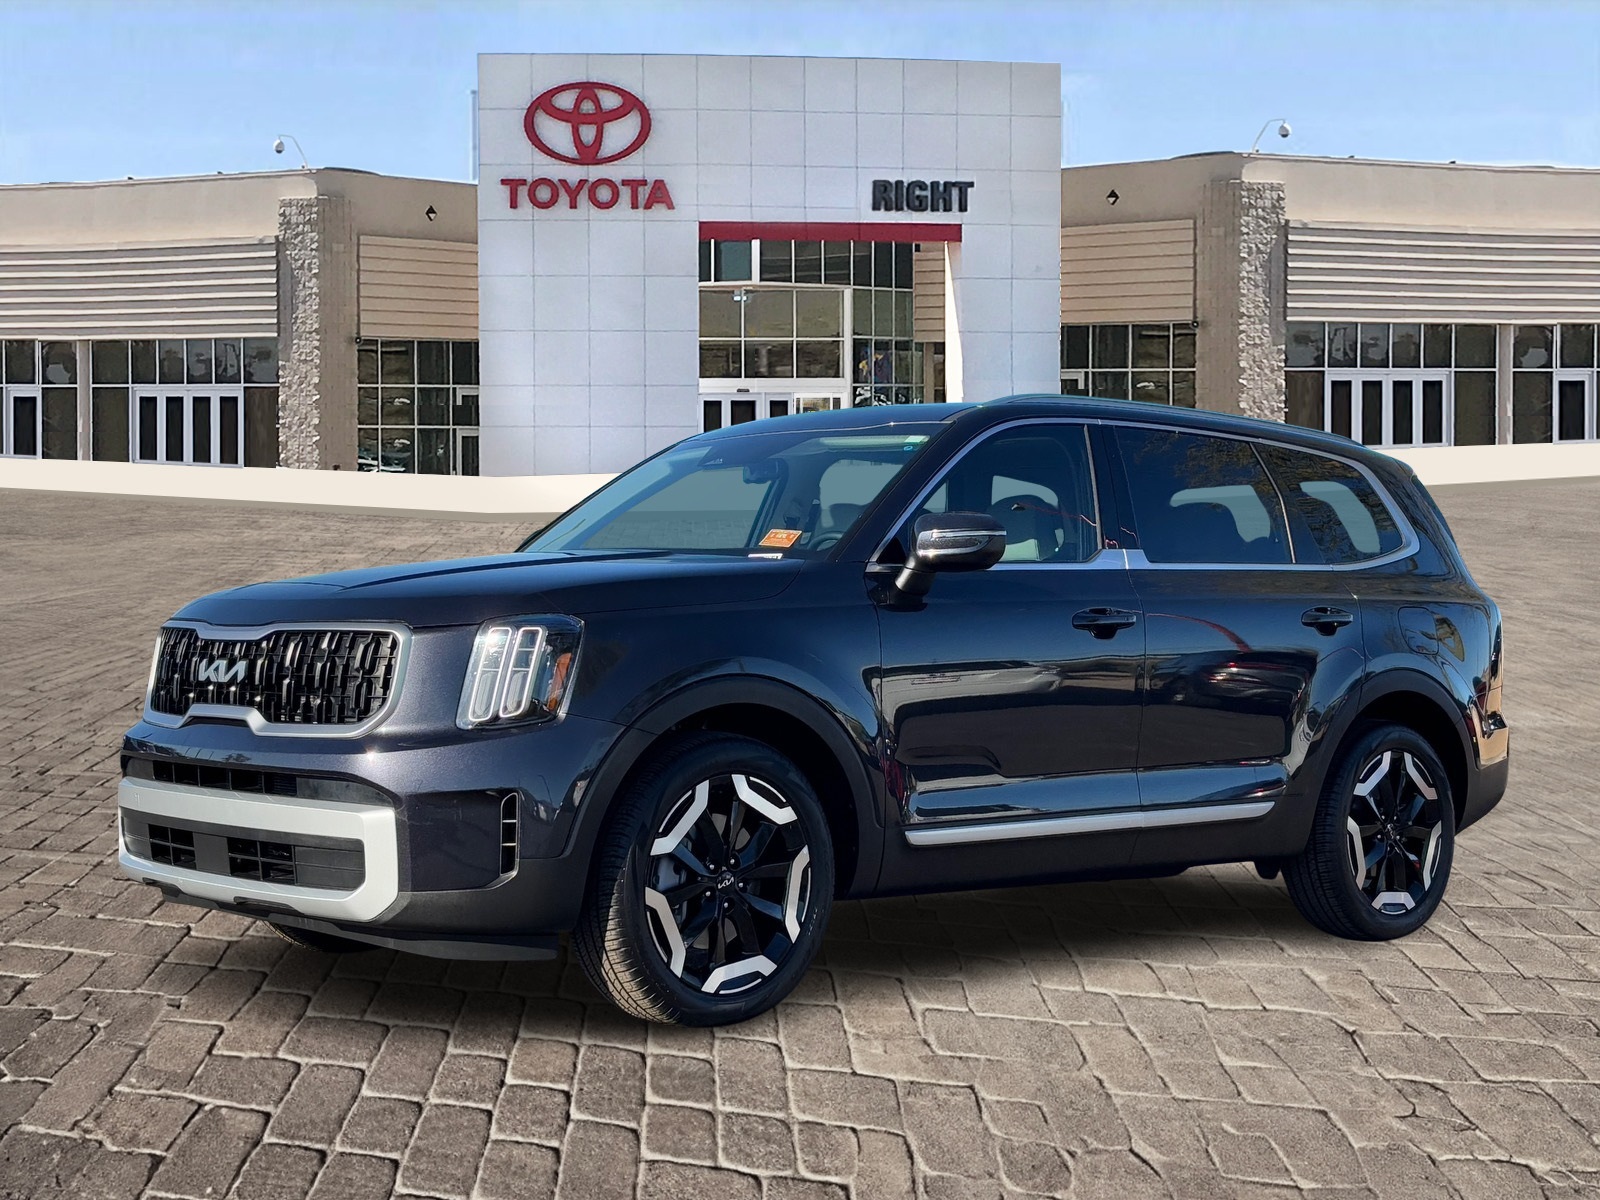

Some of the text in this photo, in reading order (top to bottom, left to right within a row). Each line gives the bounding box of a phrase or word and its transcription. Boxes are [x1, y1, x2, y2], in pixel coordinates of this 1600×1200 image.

[500, 178, 675, 210] TOYOTA
[872, 179, 975, 212] RIGHT
[198, 658, 247, 683] KIA
